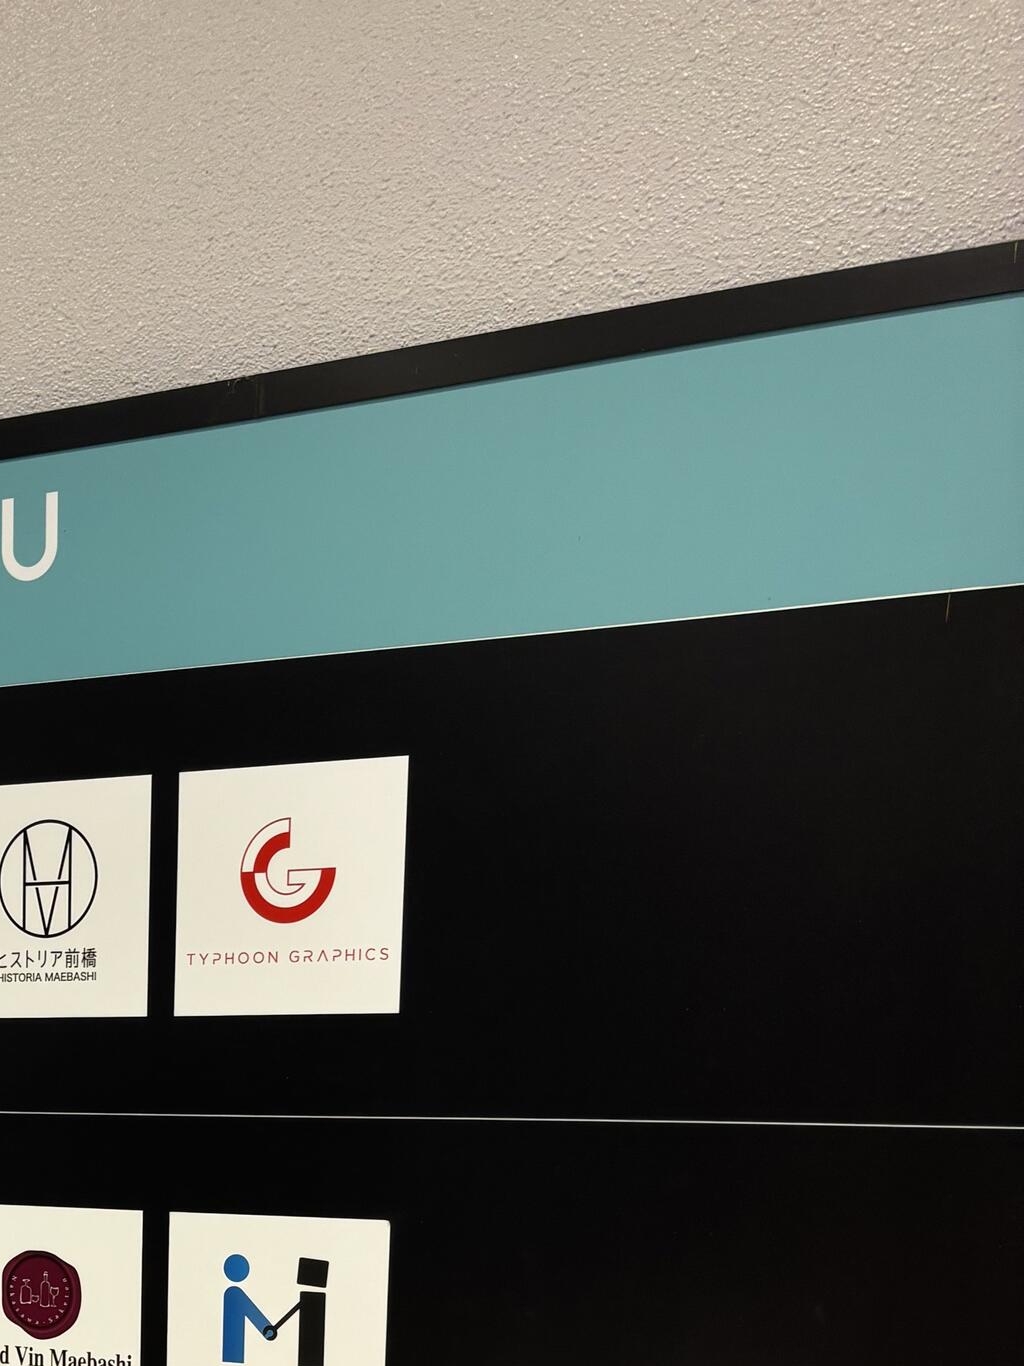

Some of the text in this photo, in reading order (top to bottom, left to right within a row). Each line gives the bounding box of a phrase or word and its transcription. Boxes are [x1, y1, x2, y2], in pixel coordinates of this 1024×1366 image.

[186, 948, 390, 966] TYPHOON GRAPHICS
[44, 971, 97, 982] MAEBASHI
[15, 1345, 44, 1366] Vin
